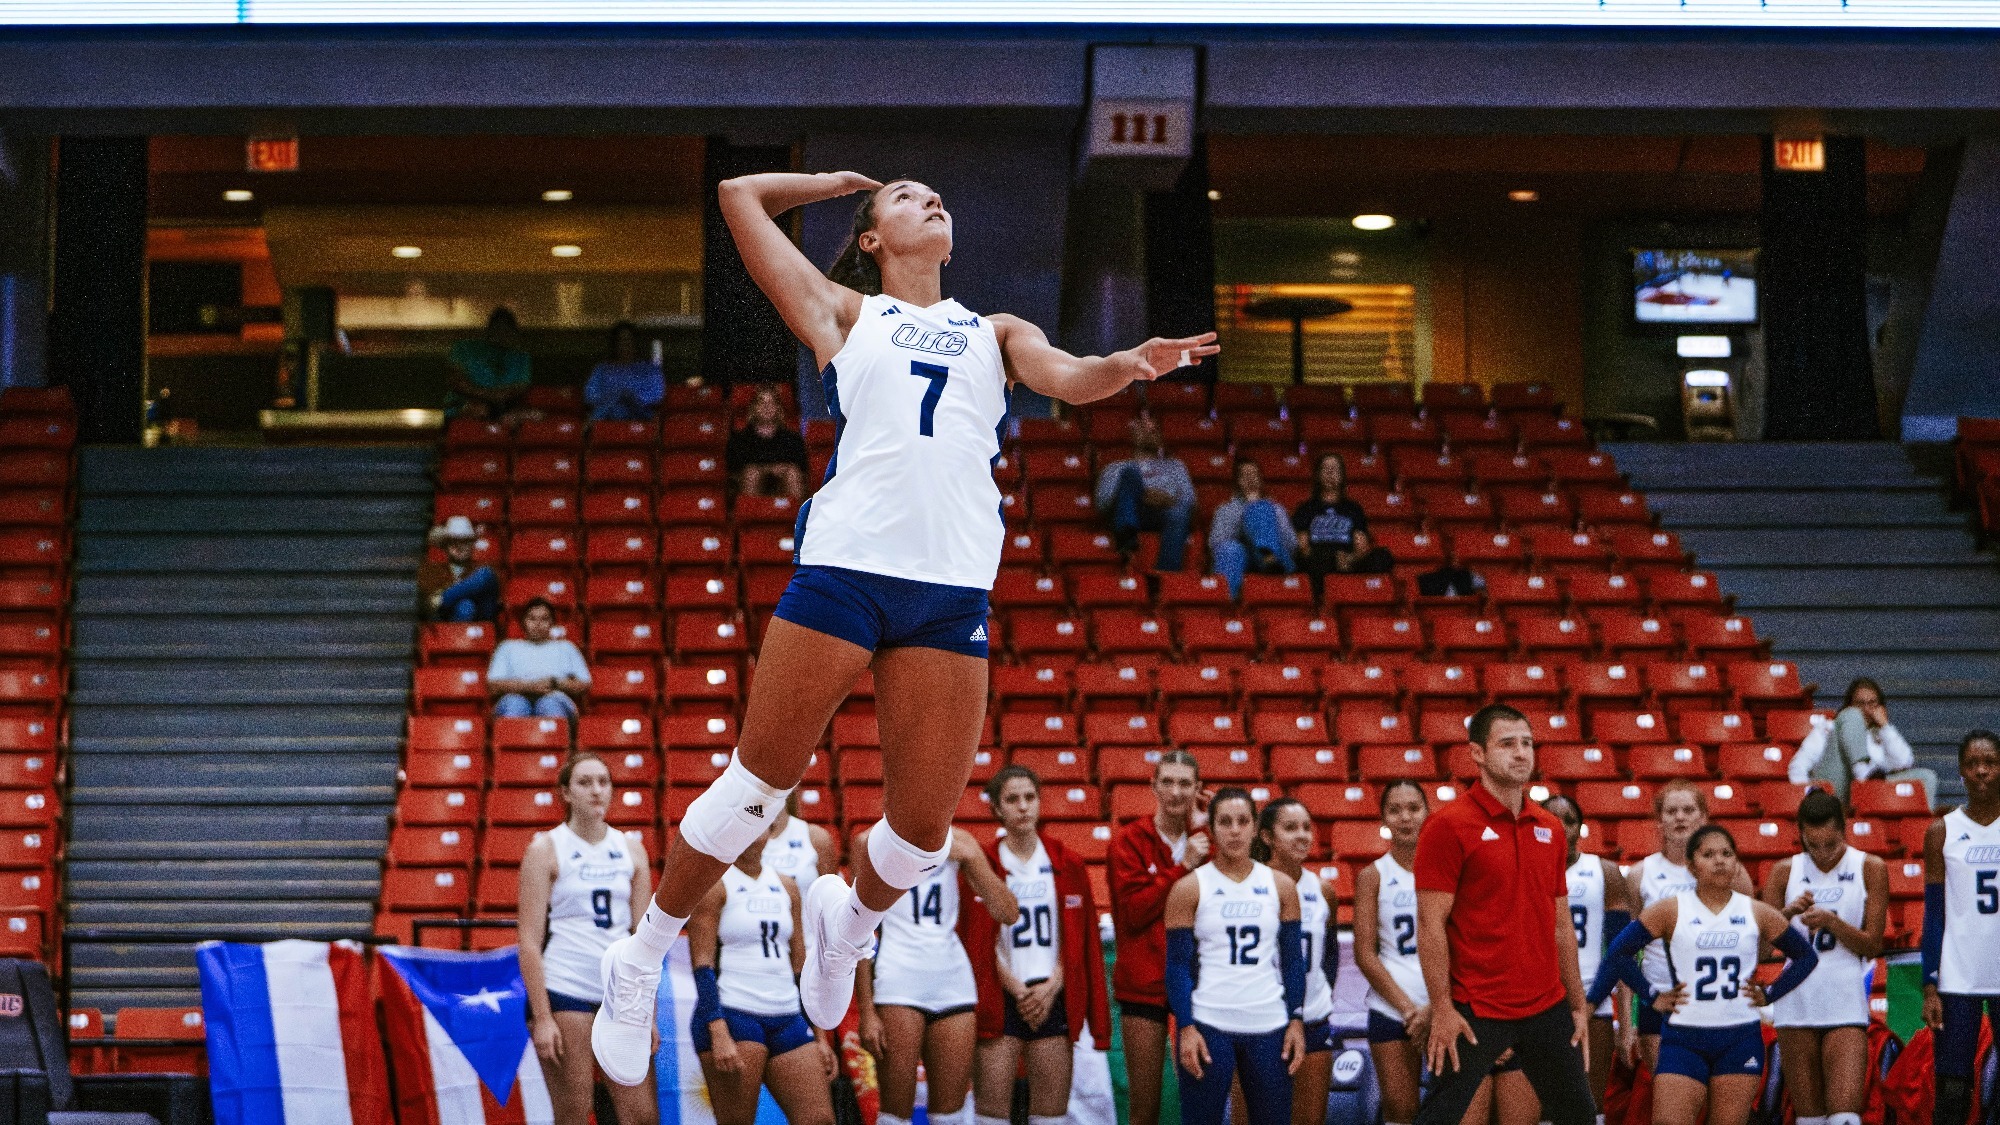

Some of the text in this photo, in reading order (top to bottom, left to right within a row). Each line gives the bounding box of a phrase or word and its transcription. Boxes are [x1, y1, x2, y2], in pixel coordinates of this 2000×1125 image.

[1110, 111, 1168, 145] 111
[892, 323, 968, 356] UIC
[910, 360, 949, 437] 7
[592, 888, 613, 929] 9
[909, 883, 942, 925] 14
[1976, 870, 1999, 915] 5
[760, 920, 781, 959] 11
[1011, 904, 1051, 948] 20
[1226, 924, 1260, 965] 12
[1393, 914, 1417, 956] 2
[1696, 930, 1740, 949] UIC
[1695, 956, 1741, 1000] 23
[1336, 1061, 1359, 1071] UIC
